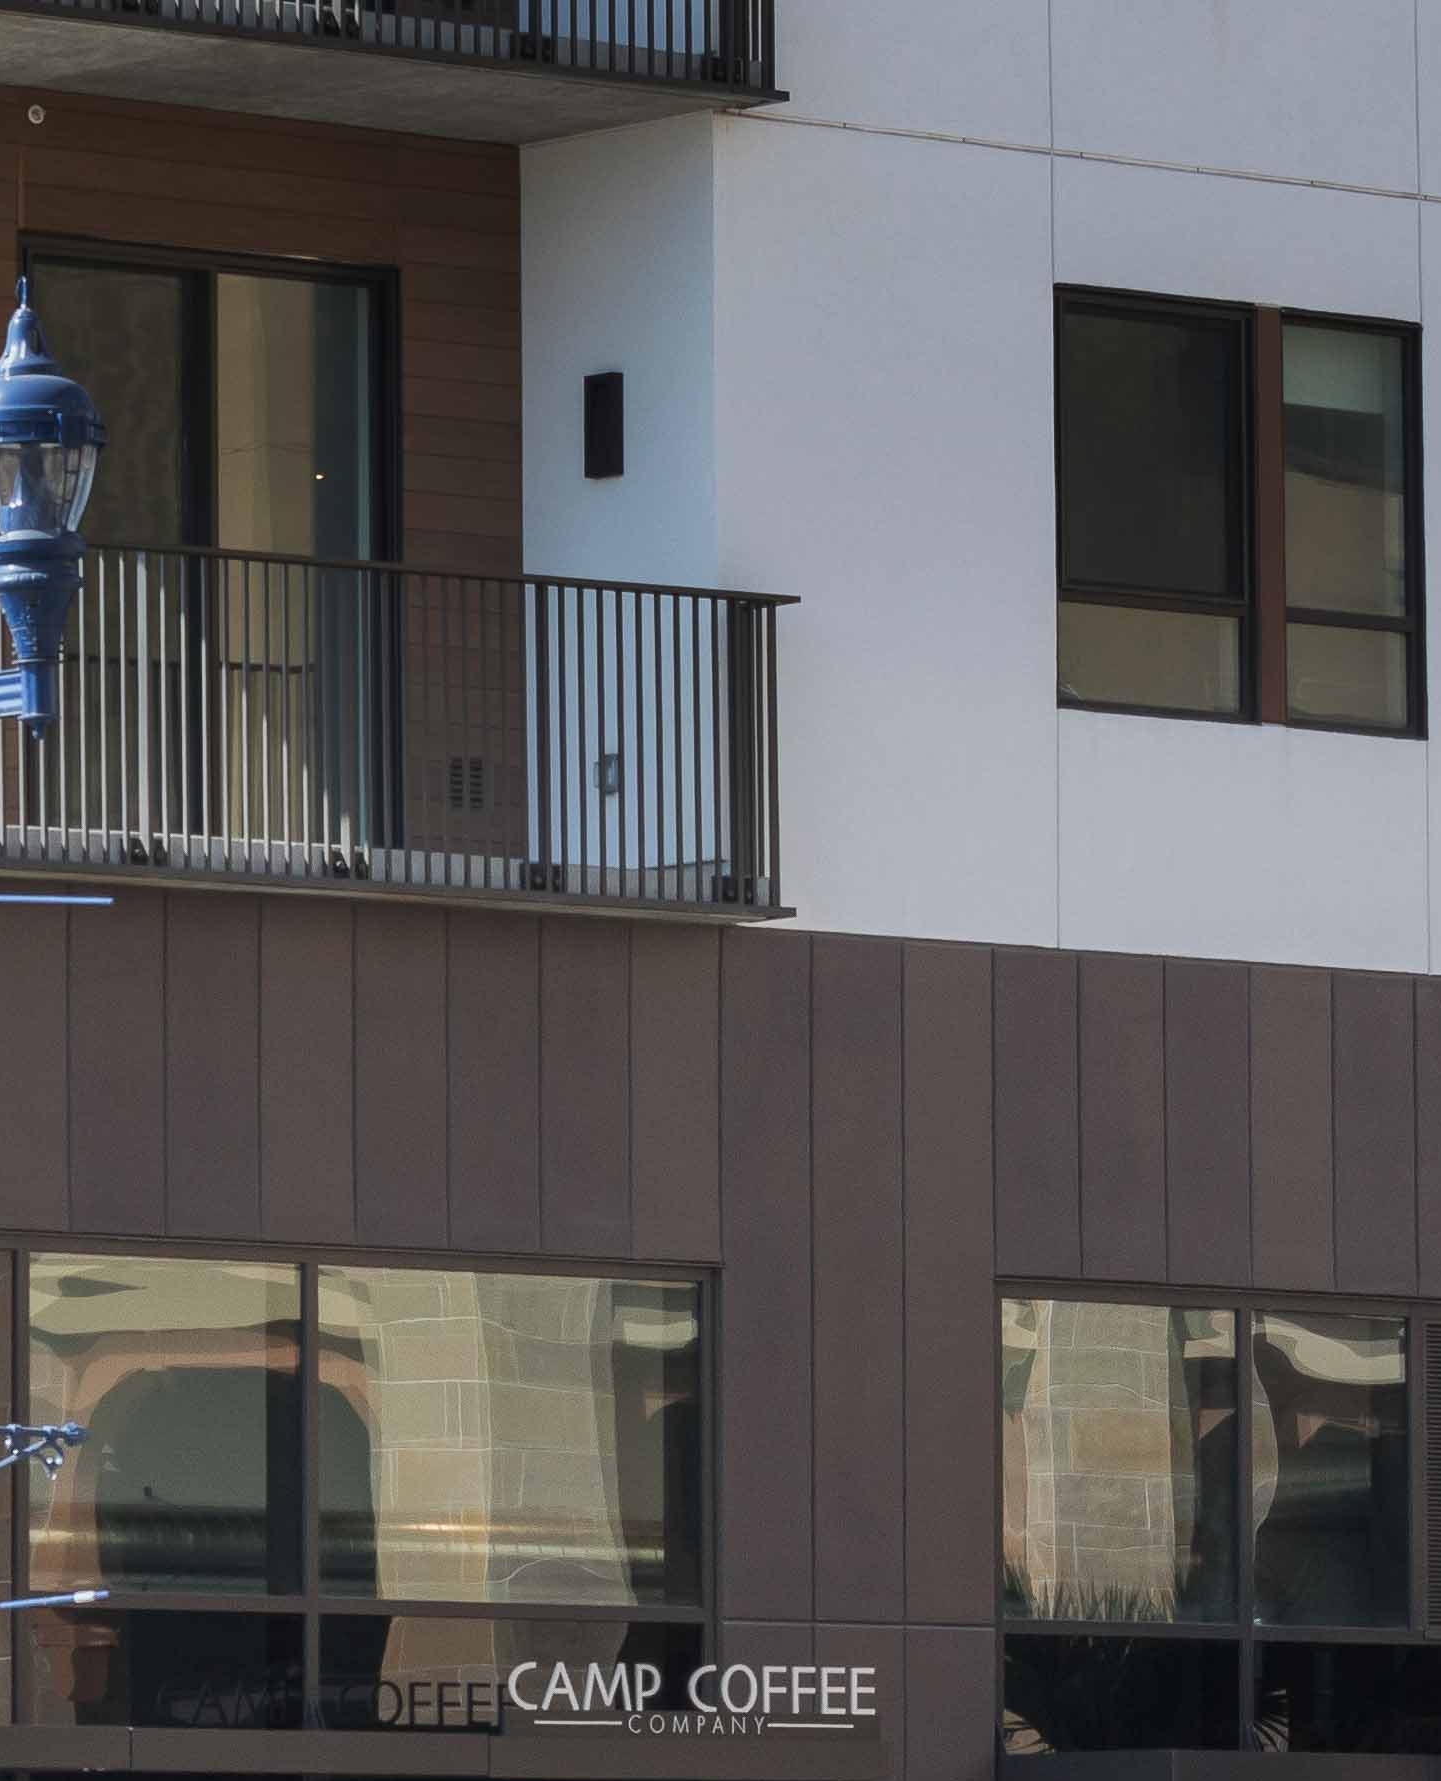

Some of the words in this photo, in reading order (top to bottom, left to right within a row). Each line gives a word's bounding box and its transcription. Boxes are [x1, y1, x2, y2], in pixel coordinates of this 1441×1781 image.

[507, 1660, 662, 1712] CAMP
[687, 1663, 877, 1716] COFFEE
[627, 1713, 767, 1736] COMPANY
